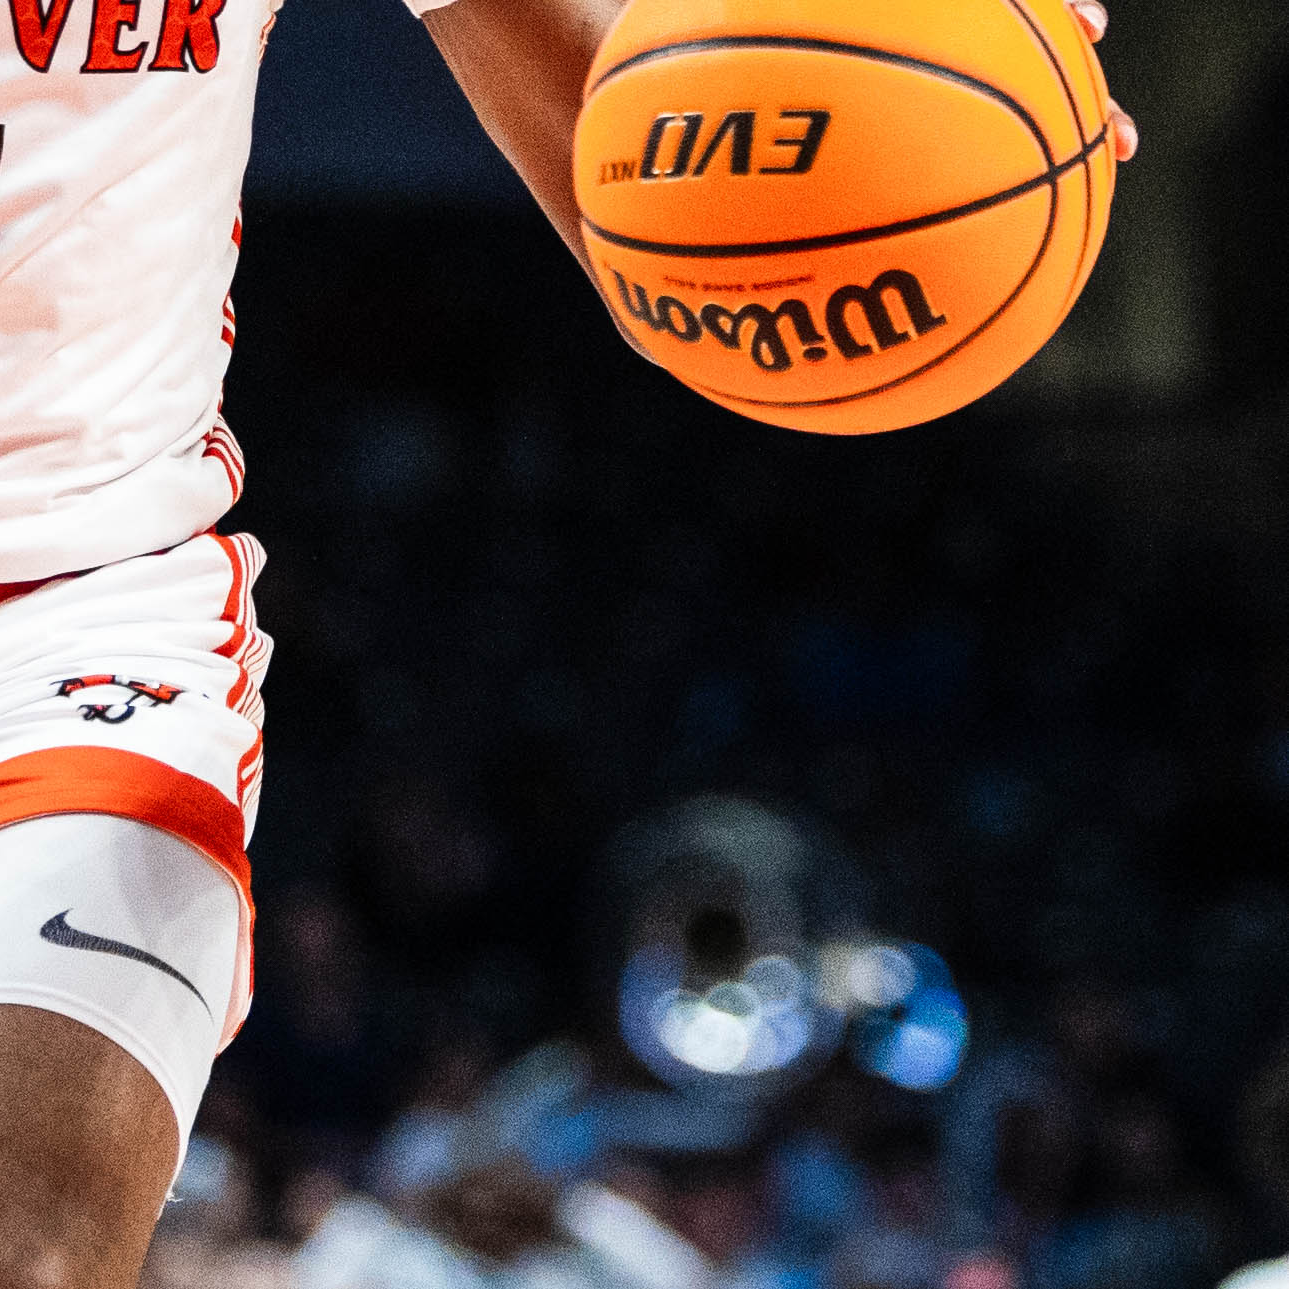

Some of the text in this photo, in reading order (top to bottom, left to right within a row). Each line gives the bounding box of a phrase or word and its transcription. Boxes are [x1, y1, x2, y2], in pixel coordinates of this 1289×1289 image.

[599, 109, 831, 186] EVO NXT
[605, 264, 947, 373] Wilson
